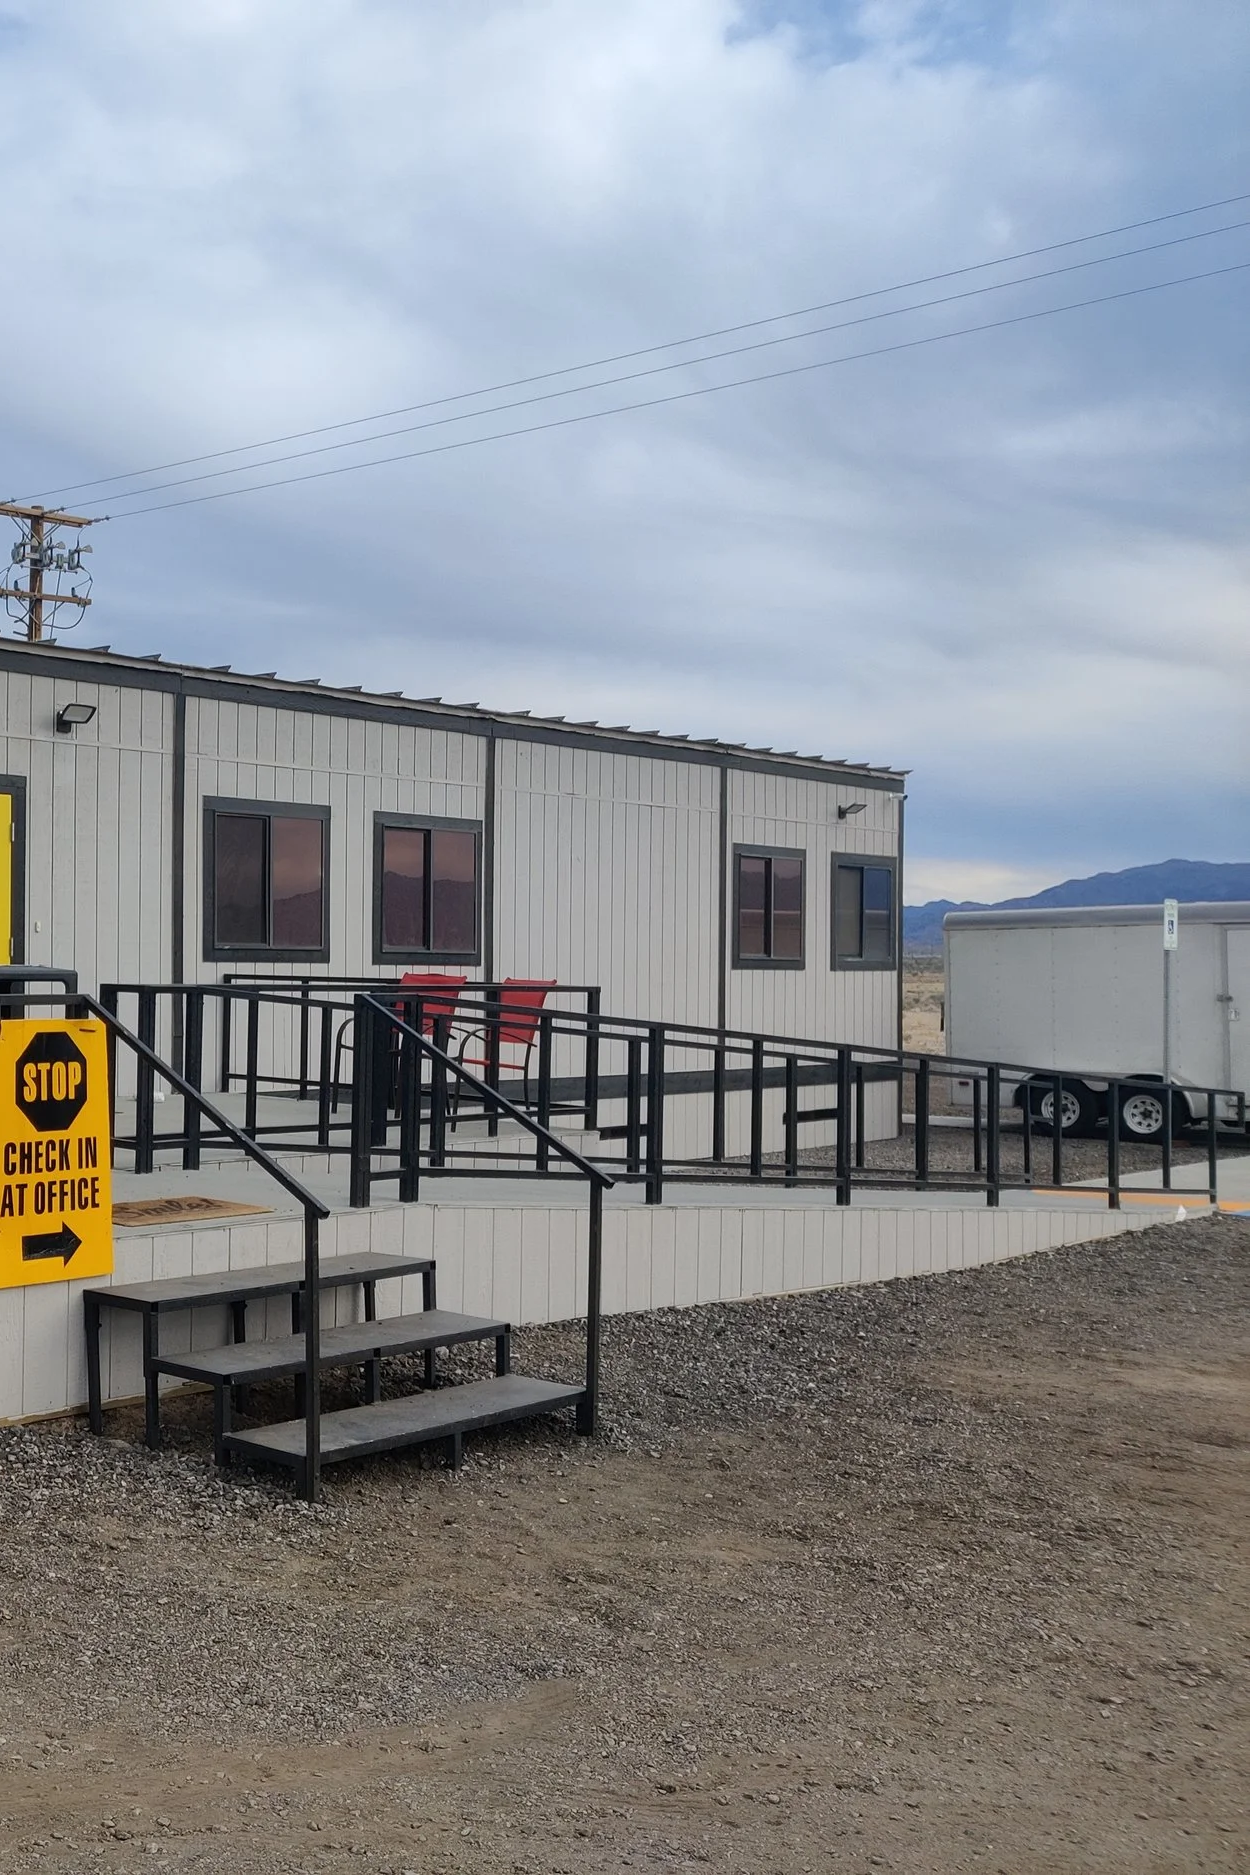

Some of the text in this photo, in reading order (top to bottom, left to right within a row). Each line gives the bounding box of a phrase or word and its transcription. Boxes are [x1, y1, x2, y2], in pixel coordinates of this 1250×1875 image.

[23, 1061, 82, 1103] STOP
[3, 1136, 98, 1176] CHECK IN
[0, 1176, 100, 1218] AT OFFICE
